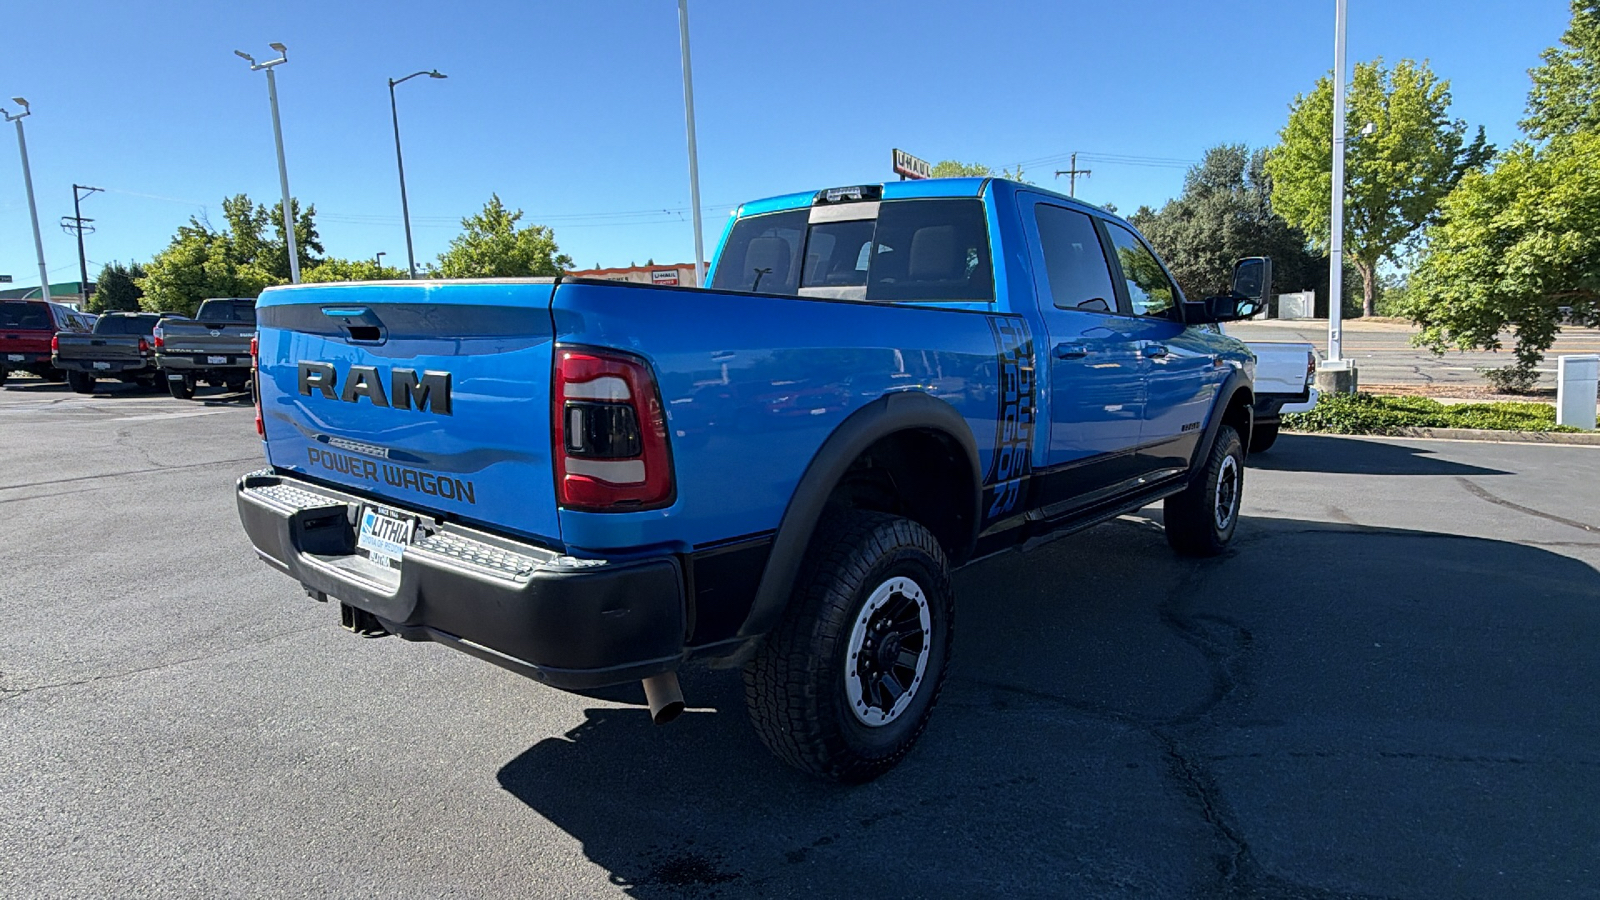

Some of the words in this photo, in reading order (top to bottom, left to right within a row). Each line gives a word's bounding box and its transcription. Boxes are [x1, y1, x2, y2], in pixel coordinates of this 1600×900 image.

[298, 360, 453, 416] RAM
[307, 447, 379, 483] POWER
[382, 464, 476, 505] WAGON
[371, 516, 409, 547] LITHIA
